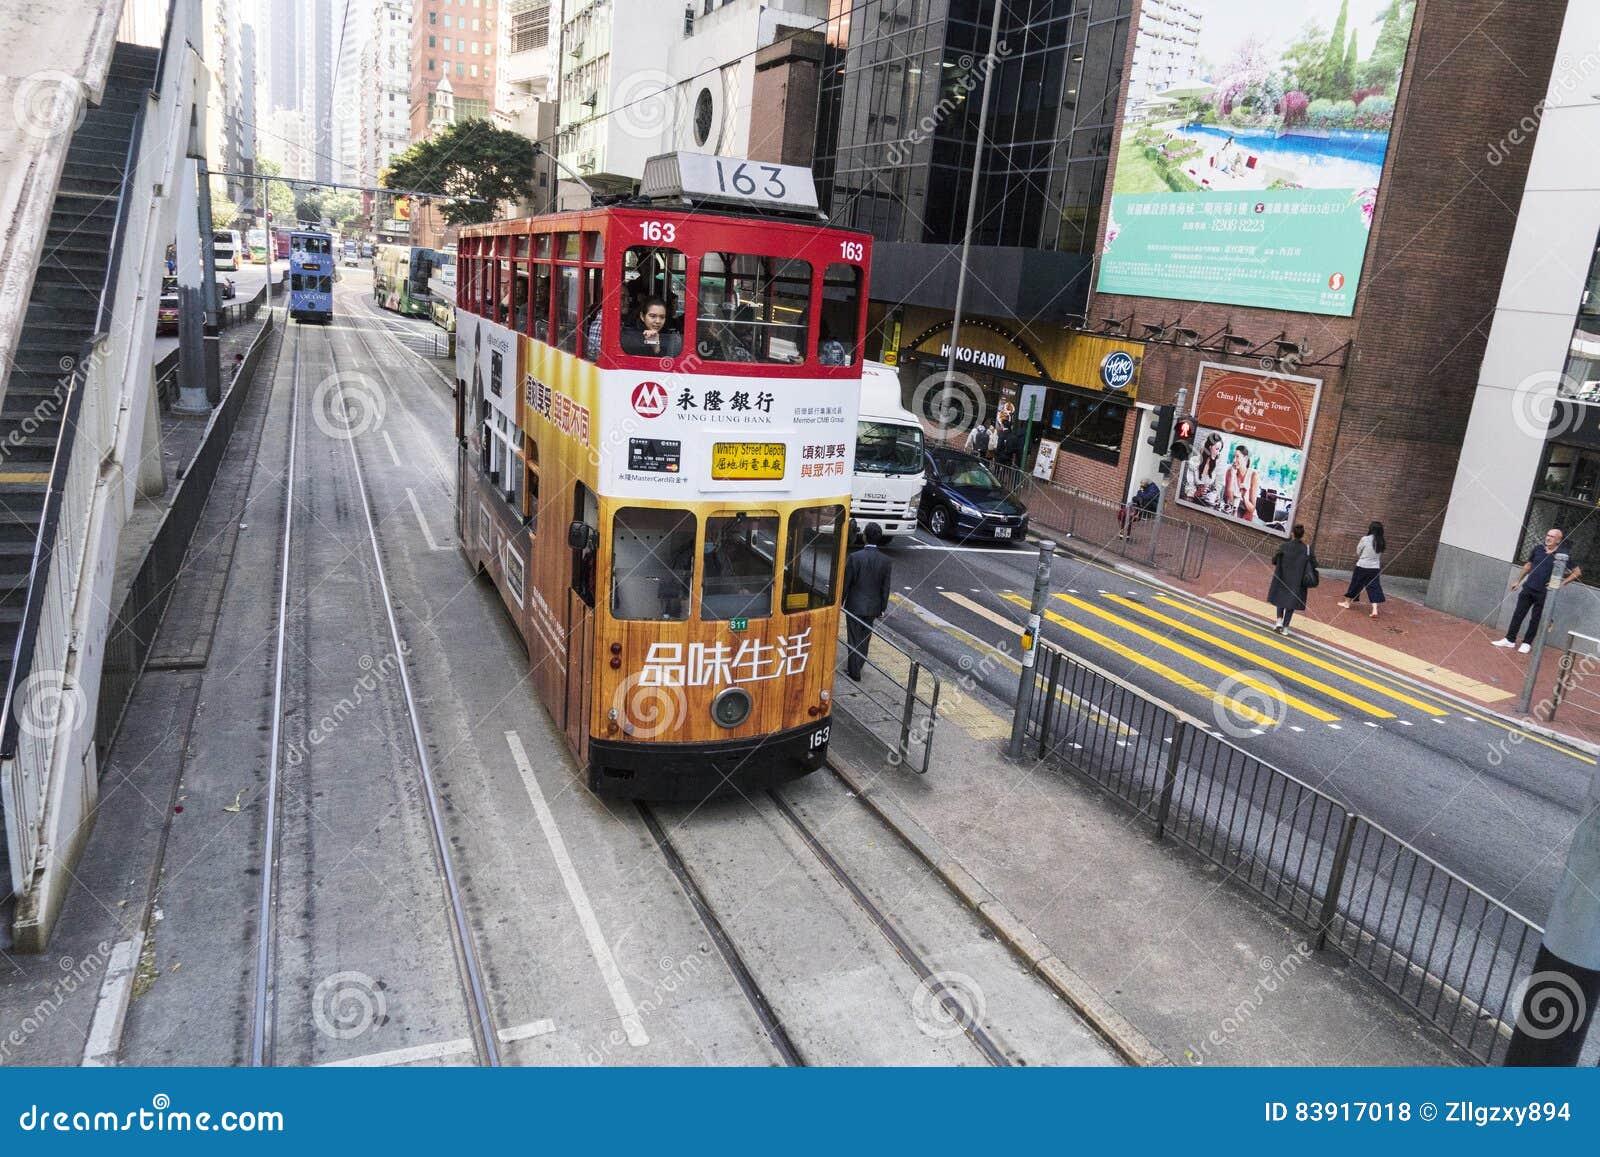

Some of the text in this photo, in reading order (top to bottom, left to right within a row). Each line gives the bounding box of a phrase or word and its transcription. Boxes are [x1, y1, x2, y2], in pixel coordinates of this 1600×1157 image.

[716, 160, 786, 199] 163
[640, 221, 676, 243] 163
[840, 241, 864, 262] 163
[972, 350, 1006, 370] FARM
[676, 387, 775, 413] 永隆銀行
[1216, 391, 1291, 412] China Hong Kong Tower
[677, 413, 772, 424] WING LUNG BANK
[816, 416, 830, 424] CMB
[717, 442, 785, 457] Whitty Street Depot
[802, 443, 846, 460] 頃刻享受
[715, 457, 782, 471] 屈地街電車廠
[800, 461, 845, 478] 與眾不同
[637, 626, 813, 687] 品味生活
[809, 726, 831, 750] 163
